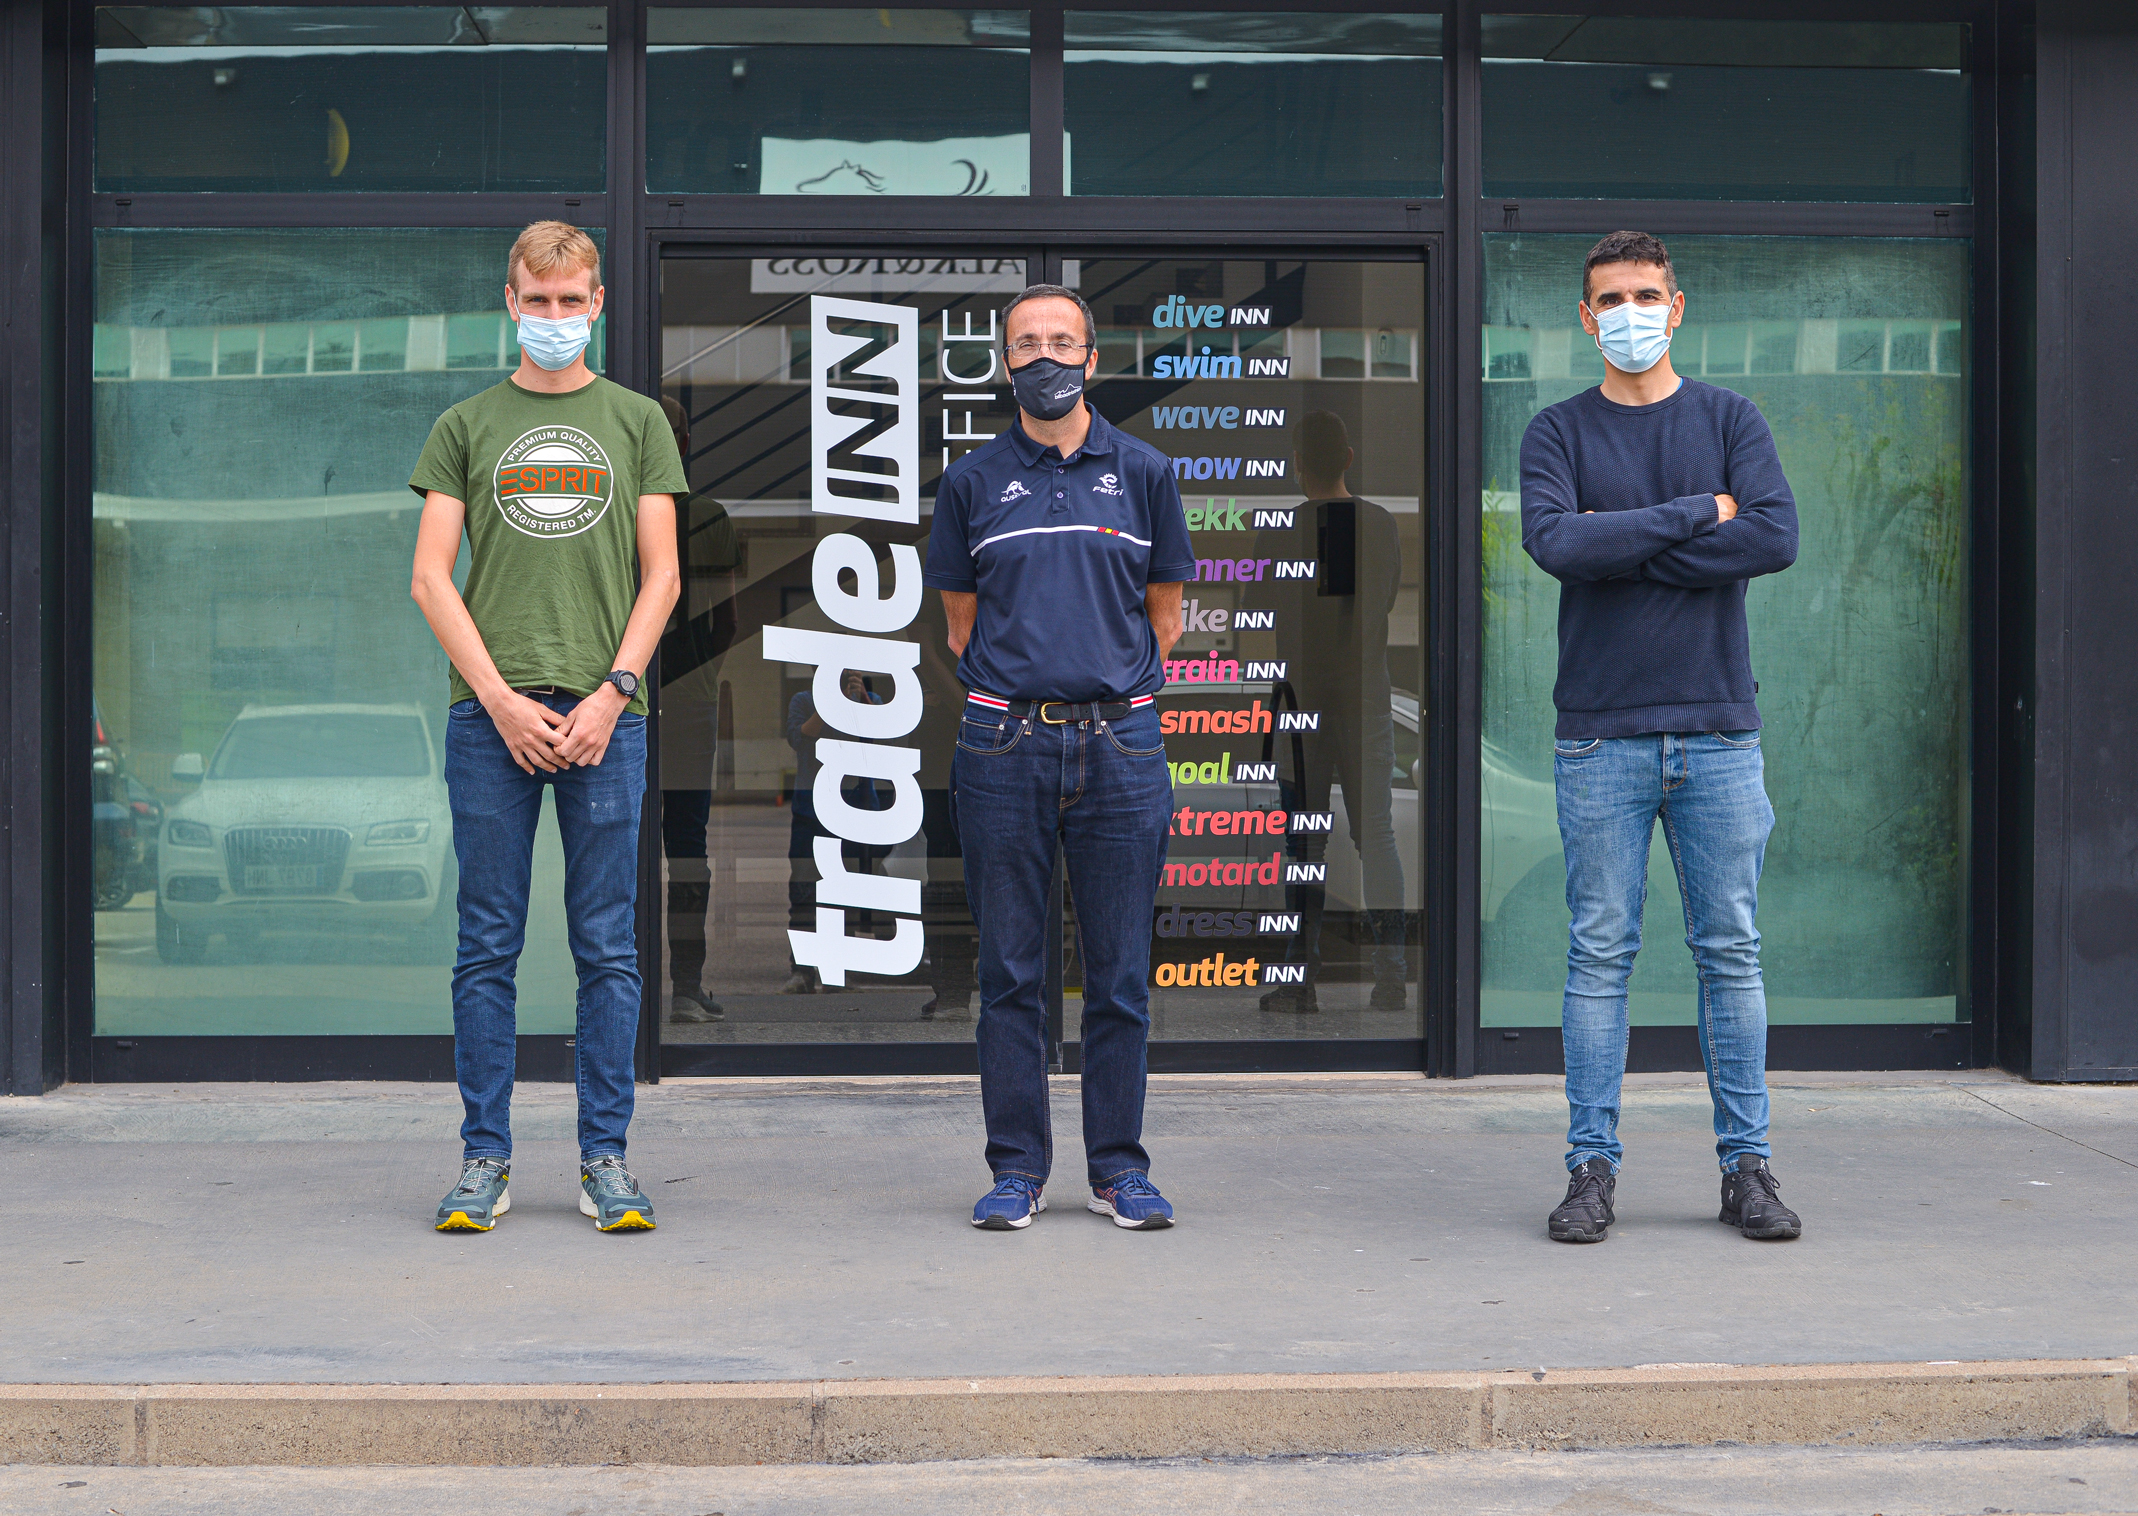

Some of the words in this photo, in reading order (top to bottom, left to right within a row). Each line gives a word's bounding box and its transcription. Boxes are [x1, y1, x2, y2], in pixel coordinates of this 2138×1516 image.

[1152, 294, 1225, 328] dive
[1229, 307, 1271, 326] INN
[1152, 346, 1243, 379] swim
[1248, 358, 1289, 377] INN
[942, 309, 997, 473] FICE
[823, 309, 904, 508] INN
[1152, 405, 1240, 430] wave
[1244, 408, 1285, 427] INN
[507, 431, 557, 462] PREMIUM
[560, 431, 602, 462] QUALITY
[500, 467, 608, 495] ESPRIT
[1168, 456, 1243, 481] now
[1245, 459, 1286, 477] INN
[507, 504, 576, 531] REGISTERED
[1184, 498, 1248, 531] ekk
[1253, 510, 1294, 528] INN
[1187, 558, 1272, 582] nner
[1274, 560, 1316, 579] INN
[1182, 598, 1229, 633] ike
[1233, 611, 1275, 629] INN
[1246, 661, 1287, 679] INN
[1160, 700, 1273, 734] smash
[1278, 712, 1319, 730] INN
[763, 533, 924, 987] trade
[1235, 763, 1277, 782] INN
[1292, 813, 1333, 832] INN
[1159, 852, 1281, 887] motard
[1285, 863, 1326, 882] INN
[1156, 903, 1253, 938] dress
[1258, 914, 1300, 933] INN
[1155, 953, 1260, 987] outlet
[1264, 965, 1306, 984] INN
